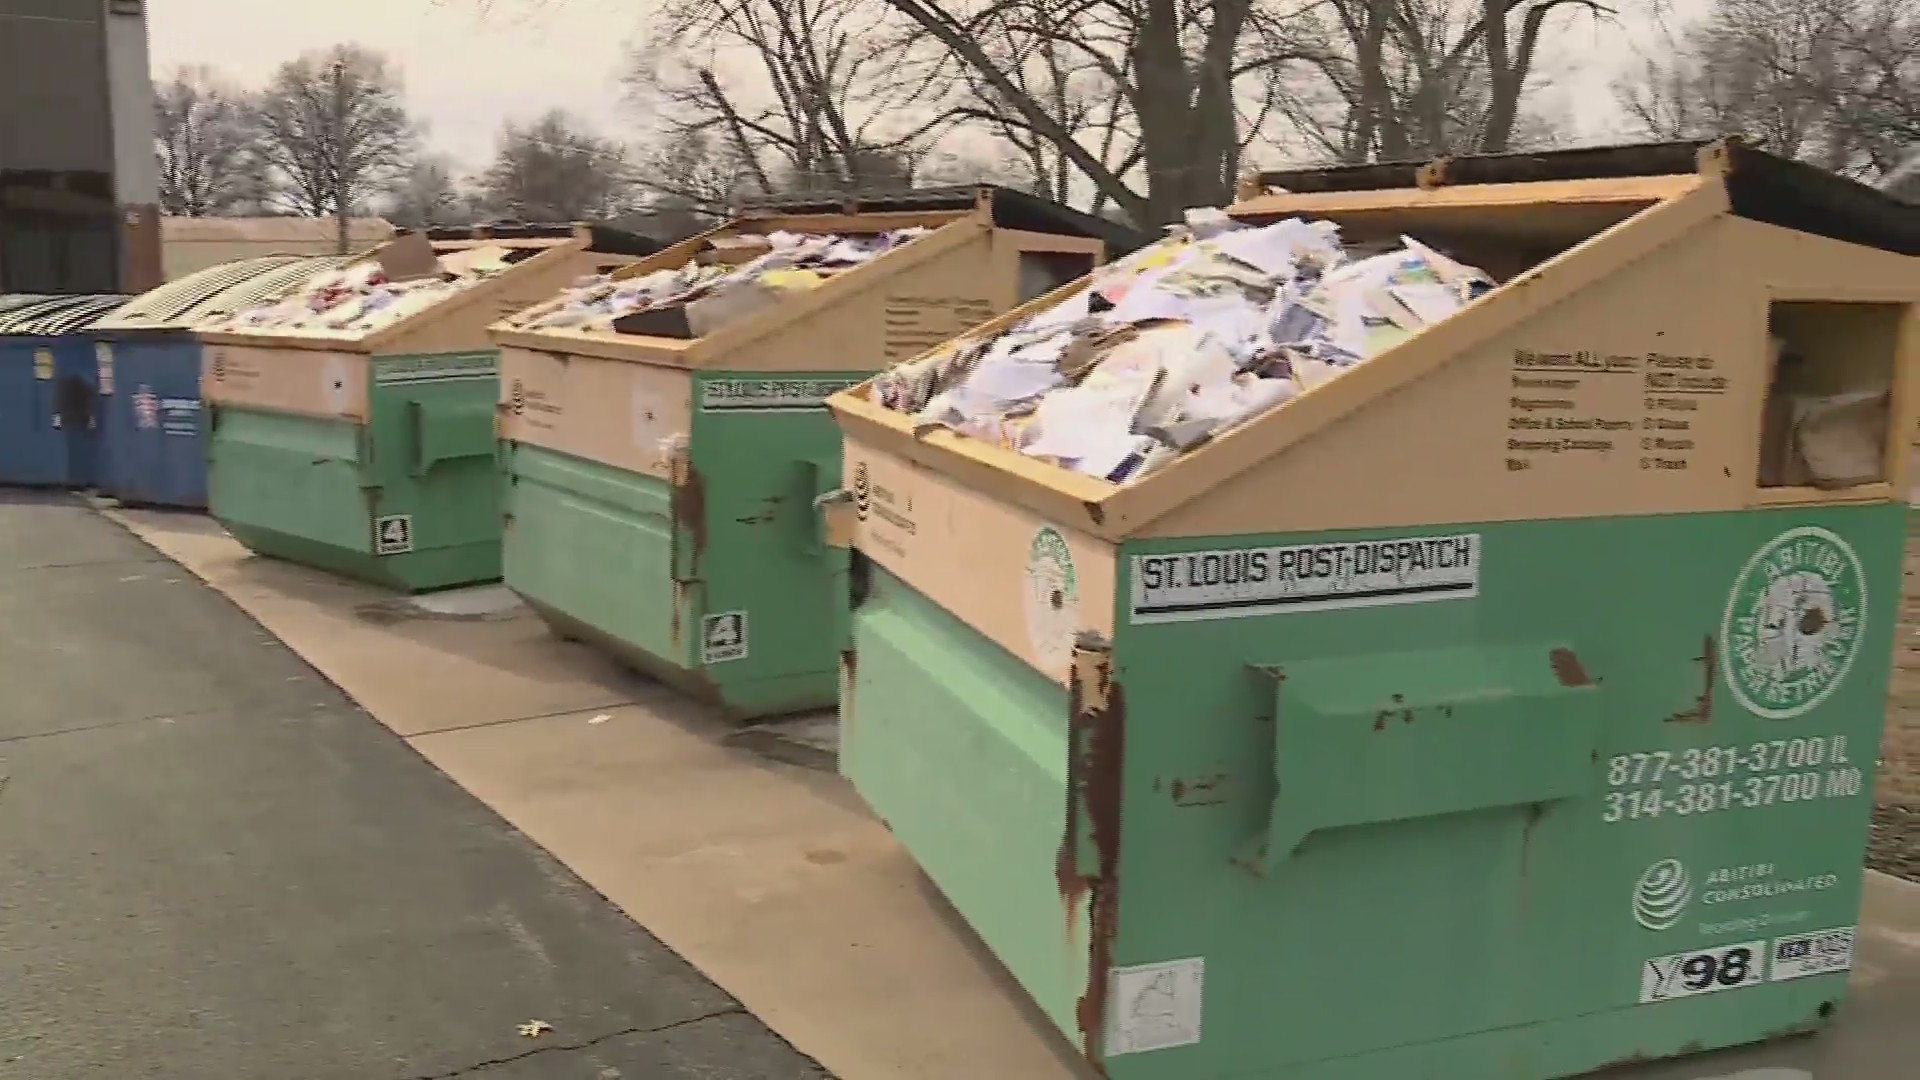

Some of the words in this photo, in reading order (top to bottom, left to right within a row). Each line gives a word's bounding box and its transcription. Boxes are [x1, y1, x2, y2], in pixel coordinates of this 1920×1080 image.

[1144, 558, 1182, 589] ST.
[1188, 551, 1269, 587] LOUIS
[1278, 537, 1470, 580] POST-DISPATCH
[1763, 541, 1847, 587] ABITIBI
[1608, 735, 1824, 786] 877-381-3700
[1603, 771, 1818, 823] 314-381-3700
[1824, 766, 1863, 797] MO
[1704, 862, 1775, 885] ABITIBI
[1704, 876, 1838, 904] CONSOLIDATED
